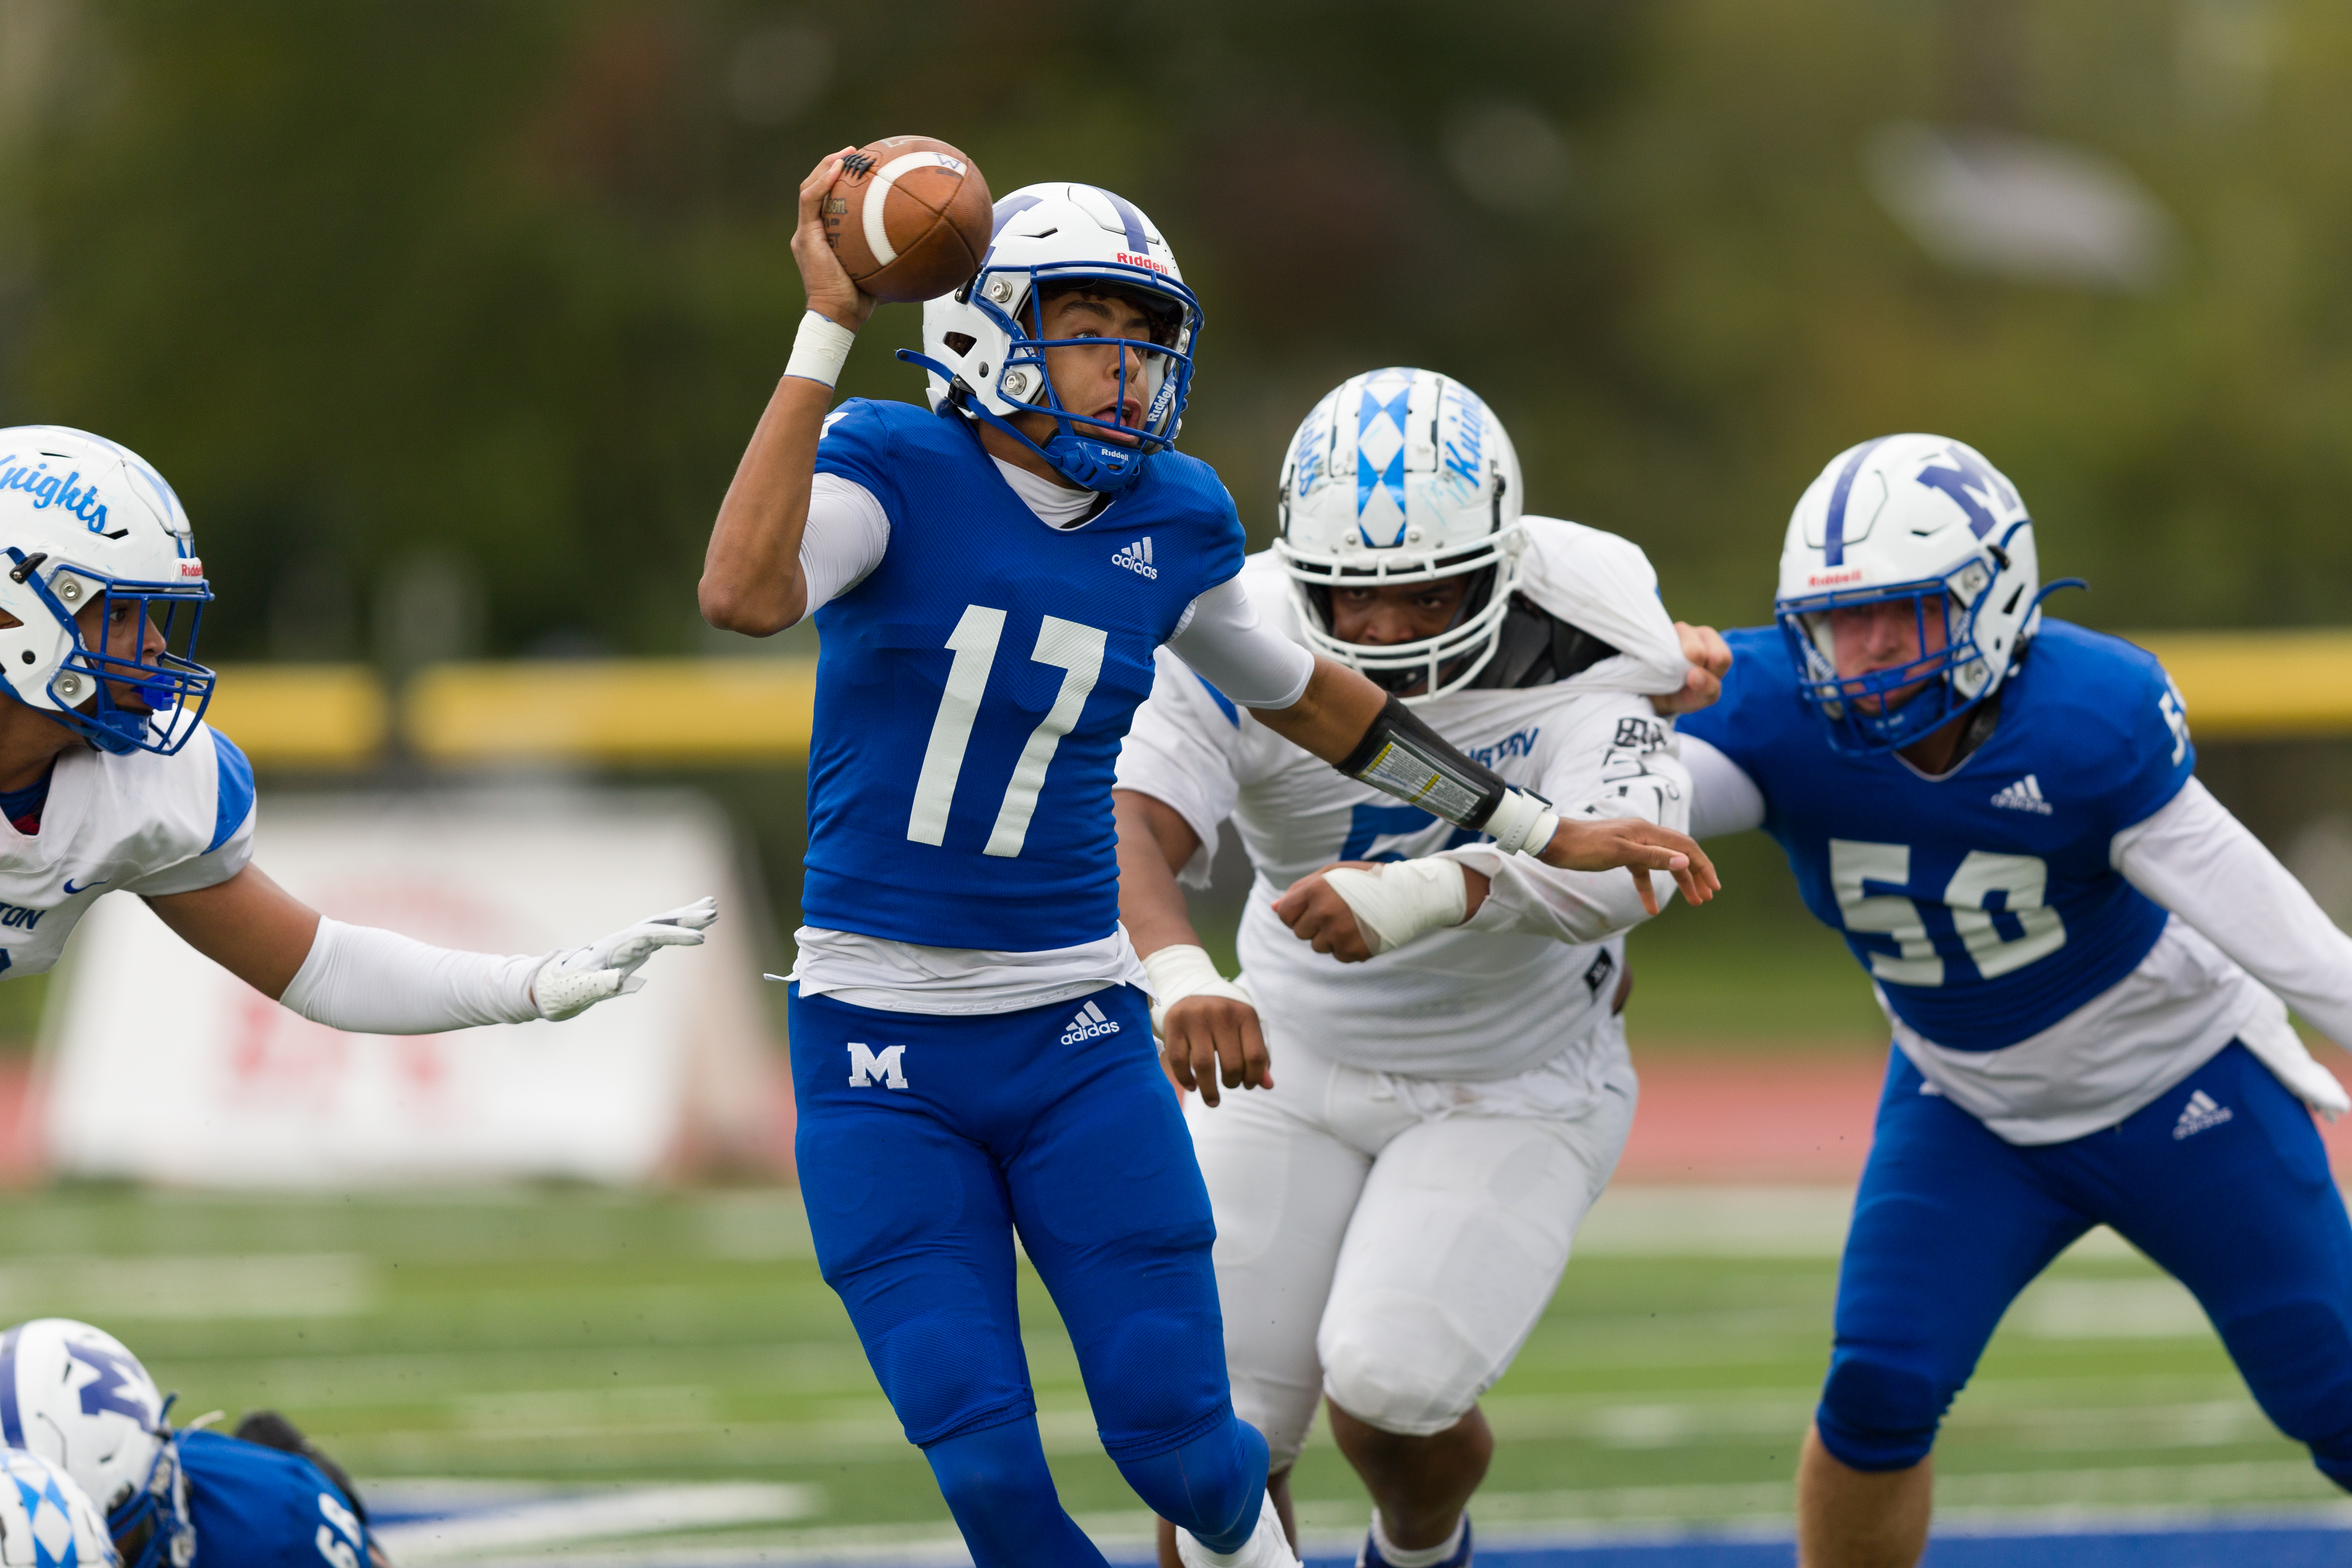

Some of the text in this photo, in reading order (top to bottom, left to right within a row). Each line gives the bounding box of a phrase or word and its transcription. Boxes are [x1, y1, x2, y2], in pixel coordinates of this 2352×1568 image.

[1117, 252, 1168, 275] Riddell
[1101, 448, 1129, 461] Riddell
[1915, 444, 2017, 541] M
[1111, 552, 1157, 580] adidas
[906, 604, 1109, 858] 17
[1990, 793, 2053, 816] adidas
[1061, 1021, 1120, 1046] adidas
[847, 1042, 908, 1089] M
